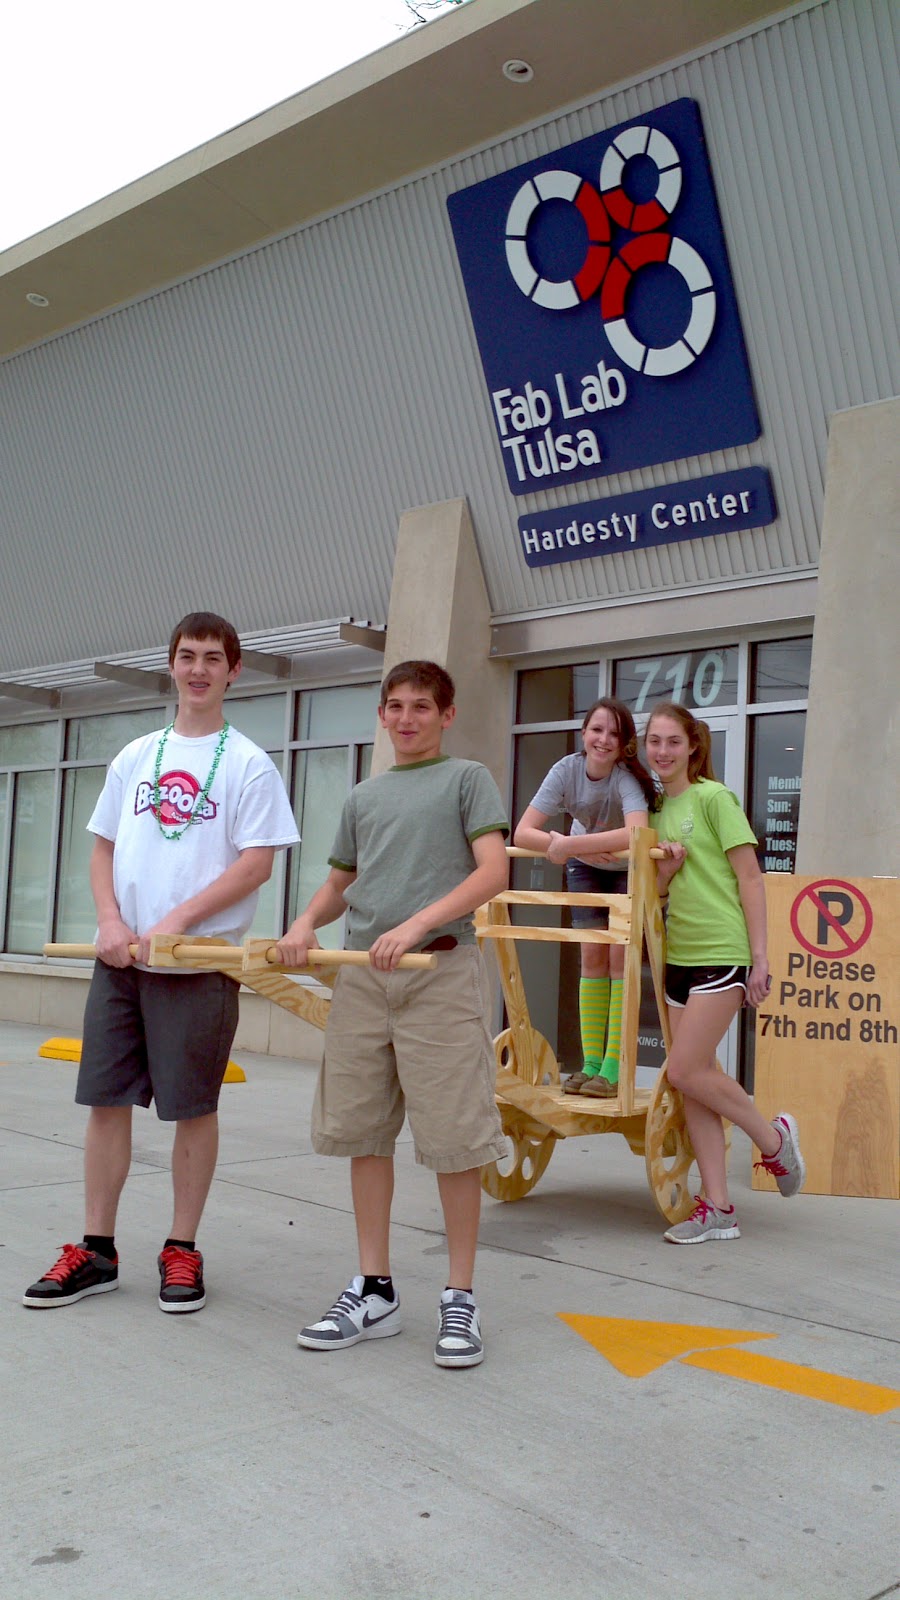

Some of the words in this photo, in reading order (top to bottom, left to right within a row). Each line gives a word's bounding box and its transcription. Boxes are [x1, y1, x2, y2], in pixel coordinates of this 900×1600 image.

[492, 381, 552, 436] Fab
[554, 359, 628, 420] Lab
[501, 427, 601, 482] Tulsa
[522, 512, 638, 554] Hardesty
[651, 490, 750, 529] Center
[633, 653, 724, 712] 710
[767, 799, 792, 813] Sun:
[766, 818, 793, 832] Mon:
[765, 837, 795, 851] Tues:
[764, 856, 793, 871] Wed:
[817, 891, 854, 945] P
[787, 953, 876, 982] Please
[779, 981, 840, 1010] Park
[848, 991, 882, 1012] on
[759, 1014, 796, 1038] 7th
[805, 1018, 850, 1041] and
[859, 1019, 898, 1043] 8th
